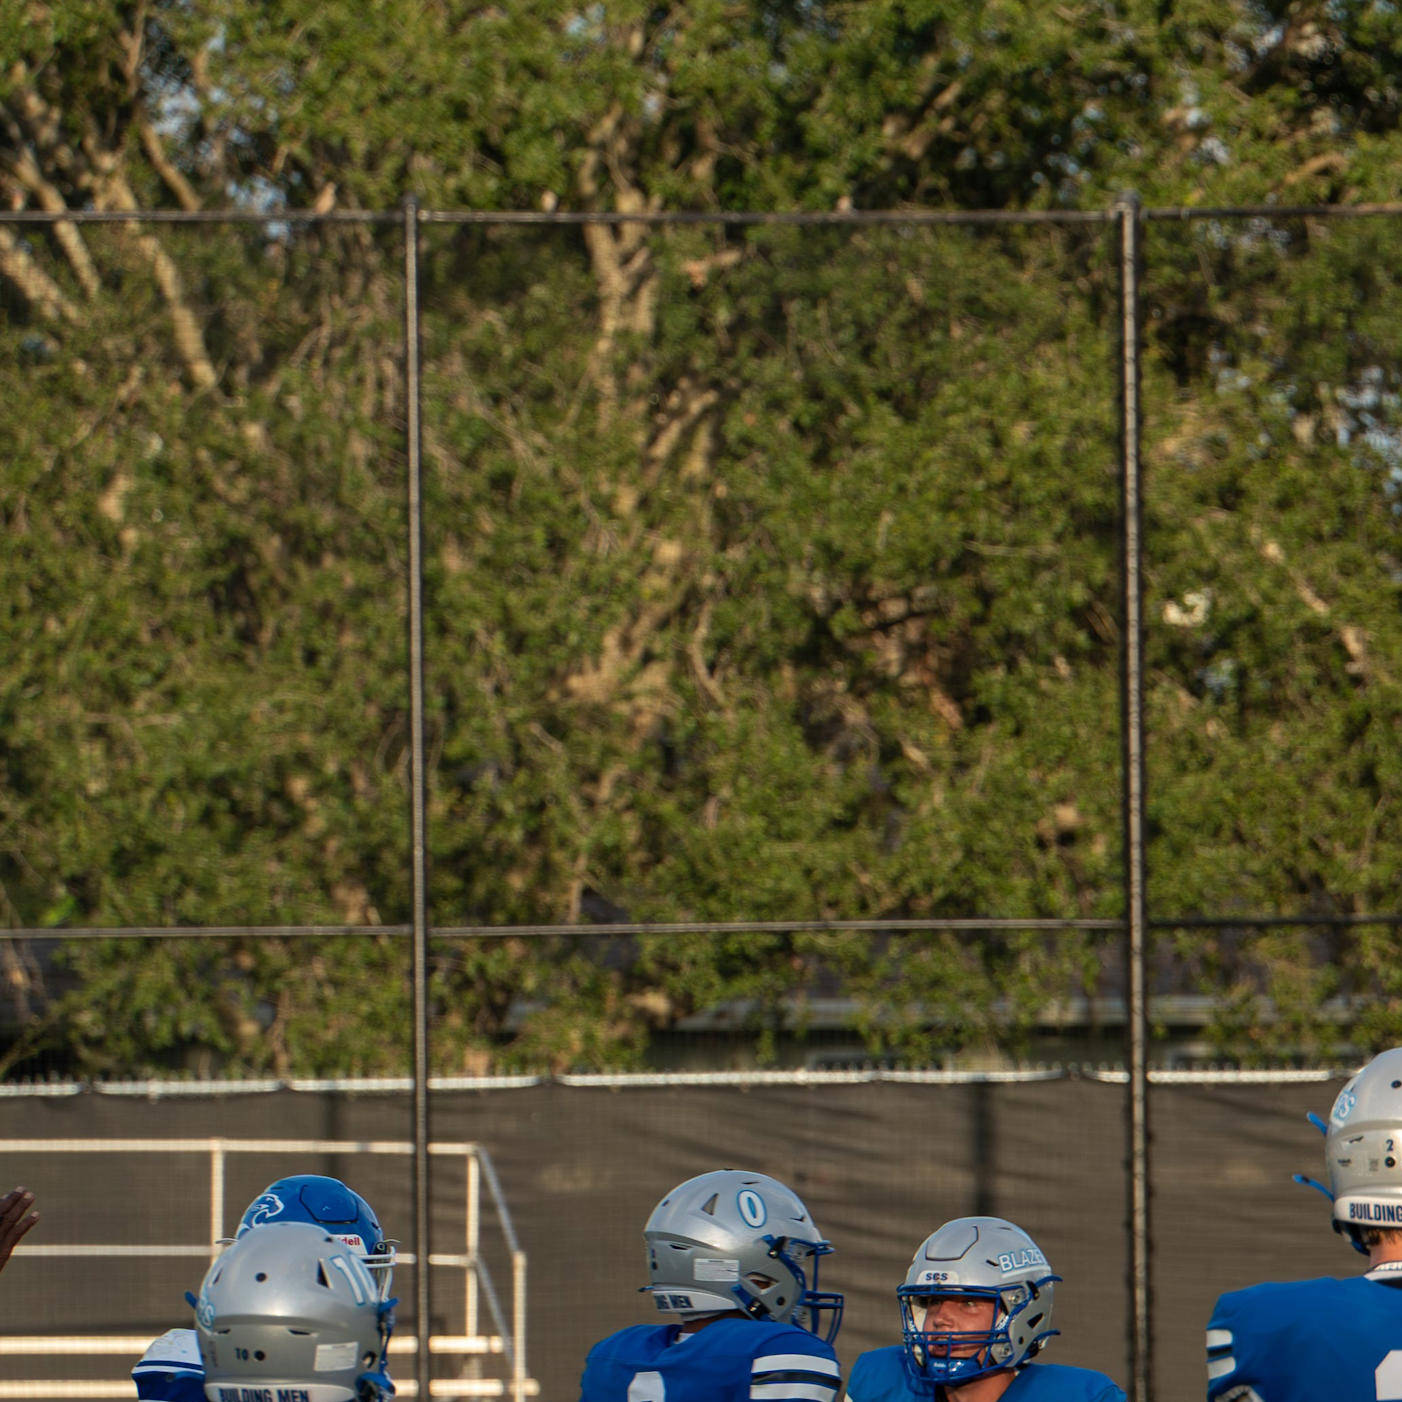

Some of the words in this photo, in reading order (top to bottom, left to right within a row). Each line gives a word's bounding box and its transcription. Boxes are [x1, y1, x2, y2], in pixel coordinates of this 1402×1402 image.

[1386, 1139, 1394, 1152] 2
[736, 1189, 768, 1229] 0
[925, 1272, 949, 1282] SCS
[236, 1347, 249, 1361] 10
